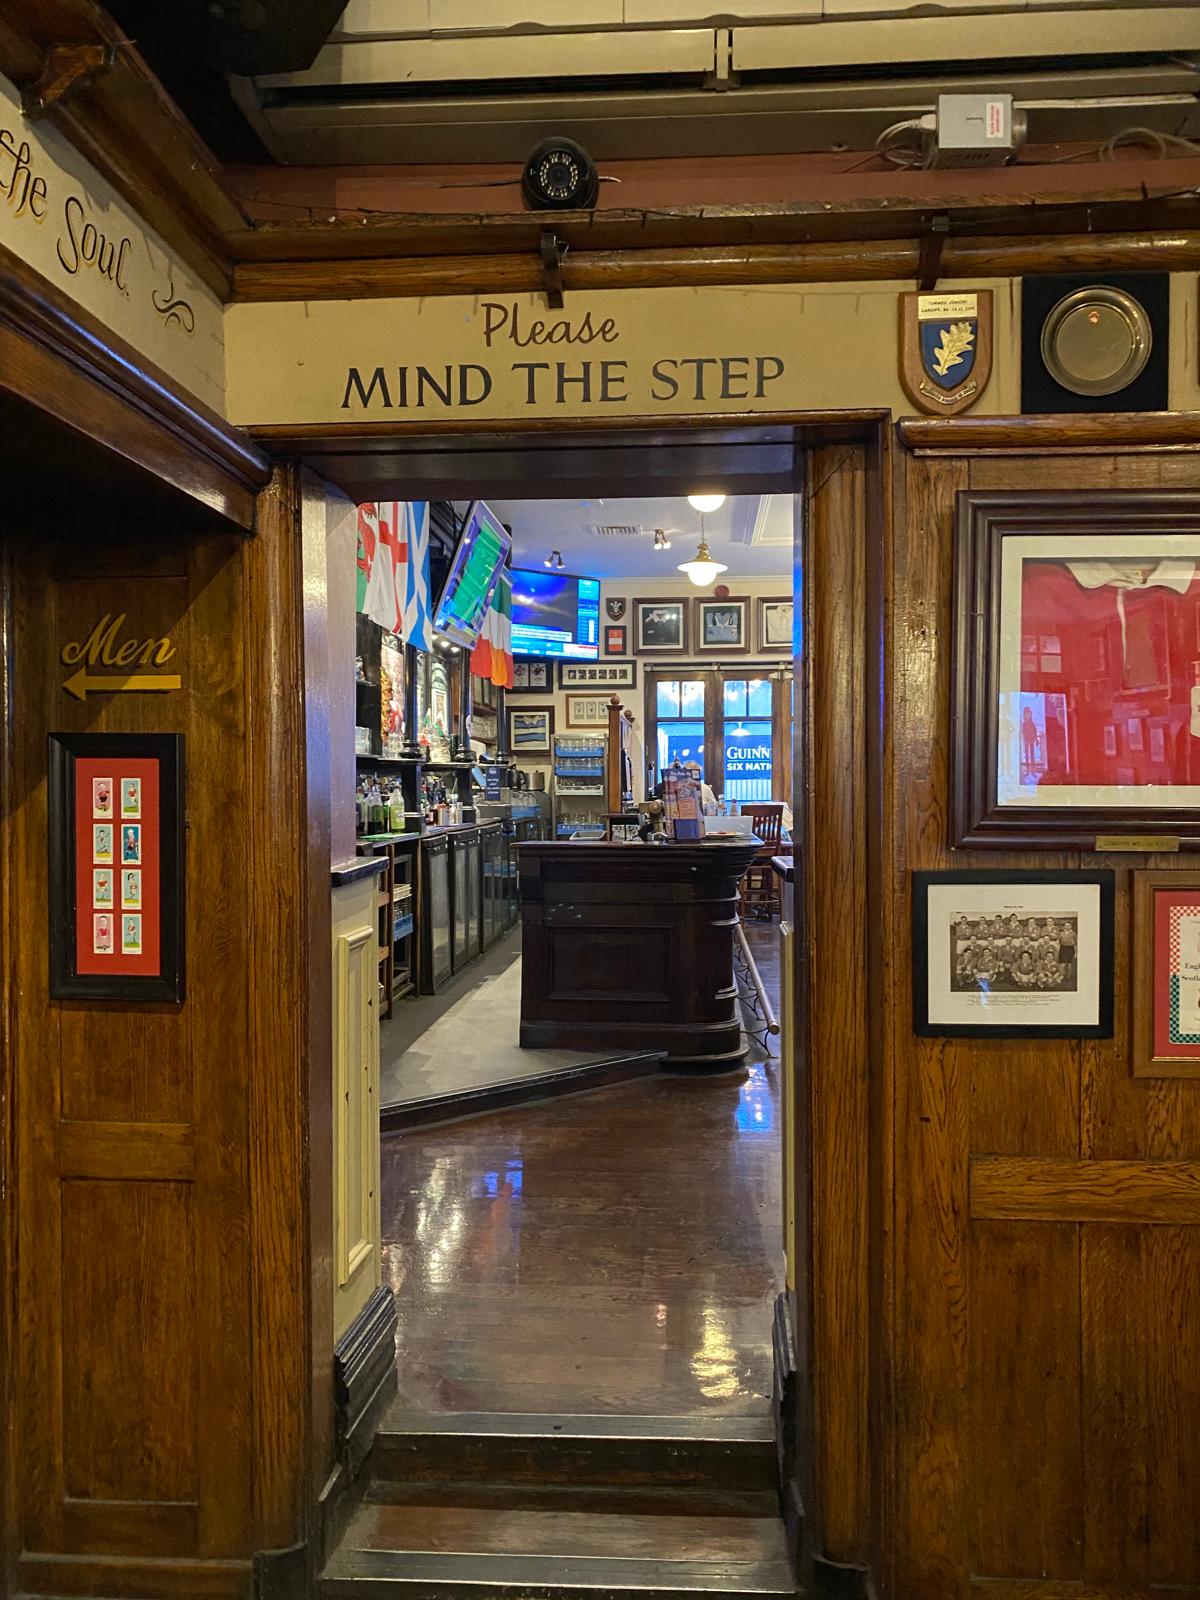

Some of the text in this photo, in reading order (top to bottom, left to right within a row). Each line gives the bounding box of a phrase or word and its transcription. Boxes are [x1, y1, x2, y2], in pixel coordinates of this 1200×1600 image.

[480, 302, 619, 347] Please
[340, 356, 785, 409] MIND THE STEP
[61, 613, 177, 666] Men
[726, 762, 744, 771] SIX
